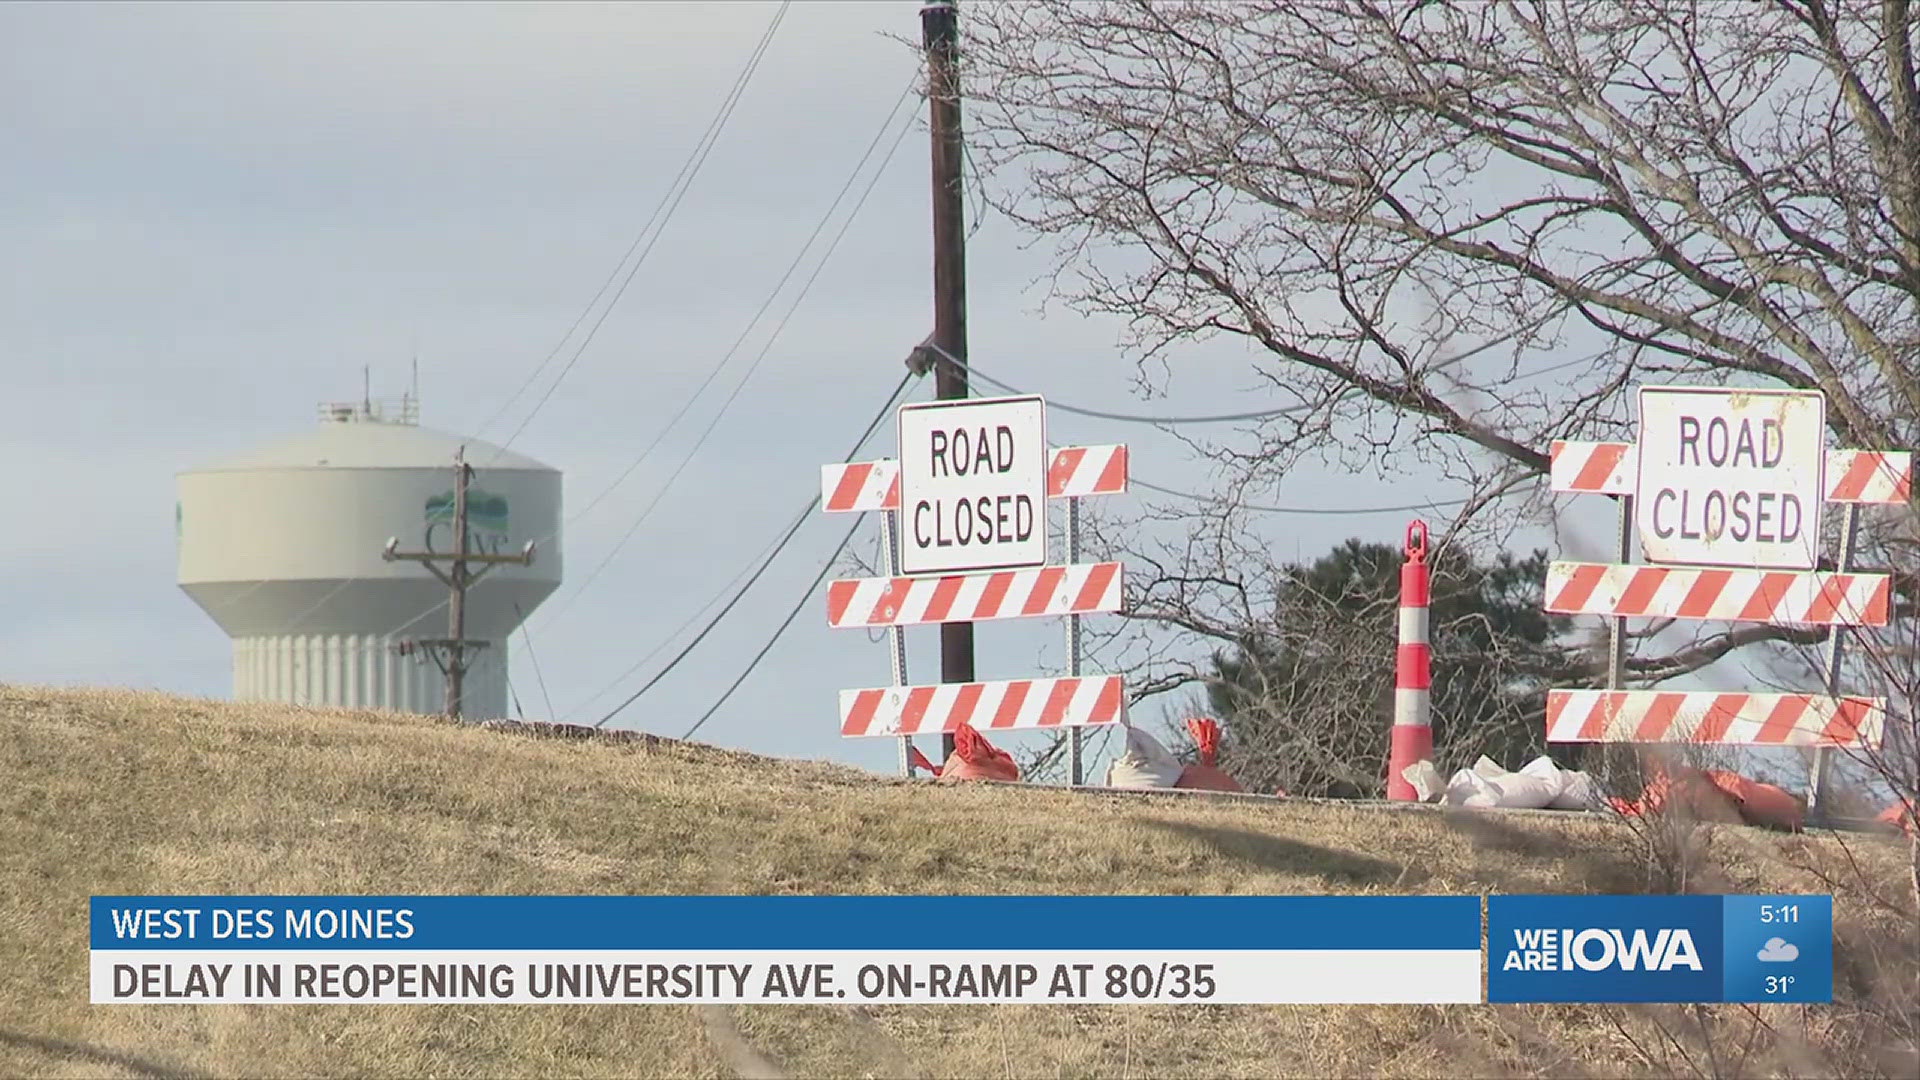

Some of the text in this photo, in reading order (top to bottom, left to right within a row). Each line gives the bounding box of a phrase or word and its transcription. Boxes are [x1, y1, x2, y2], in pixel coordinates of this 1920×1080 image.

[930, 425, 1014, 477] ROAD
[1679, 415, 1783, 468] ROAD
[914, 494, 1034, 549] CLOSED
[1653, 488, 1801, 543] CLOSED
